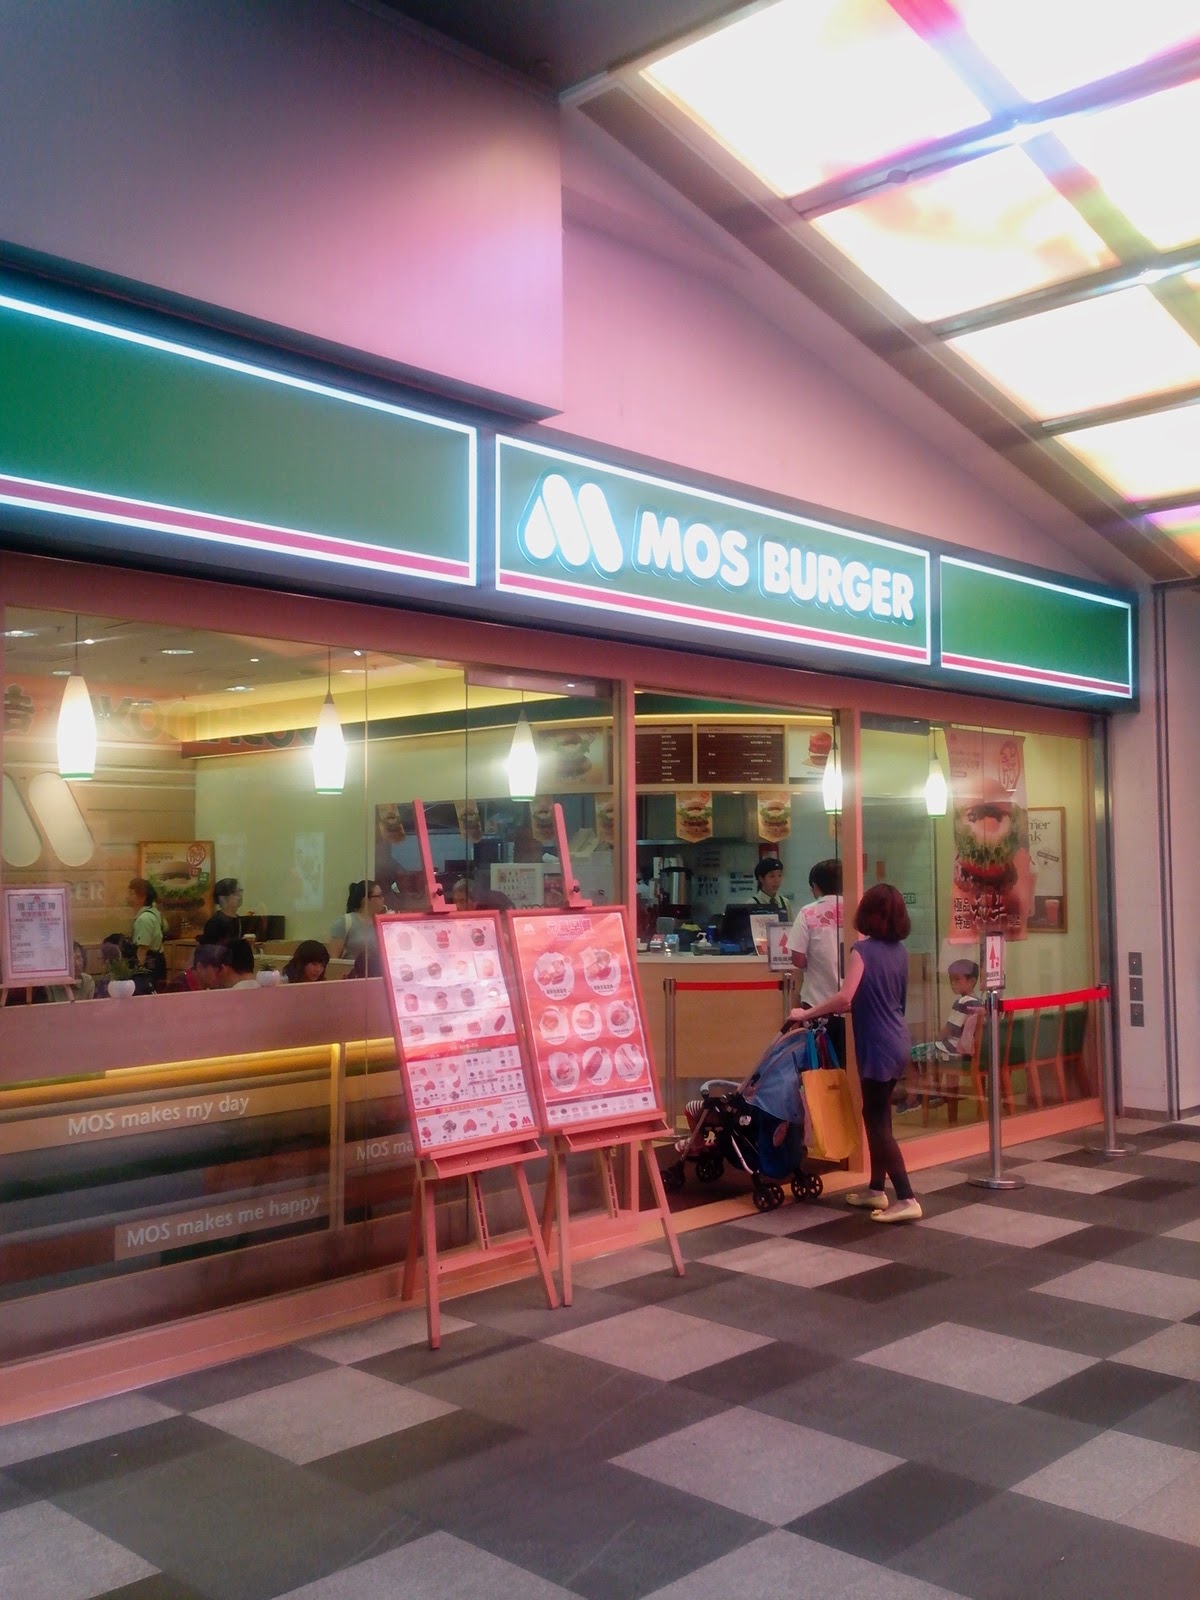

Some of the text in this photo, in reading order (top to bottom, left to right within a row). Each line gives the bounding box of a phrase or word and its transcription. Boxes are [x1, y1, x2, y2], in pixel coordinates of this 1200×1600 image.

[637, 510, 914, 621] MOS BURGER
[68, 1095, 250, 1136] MOS makes my day
[356, 1139, 414, 1161] MOS ma
[126, 1195, 321, 1248] MOS makes me happy
